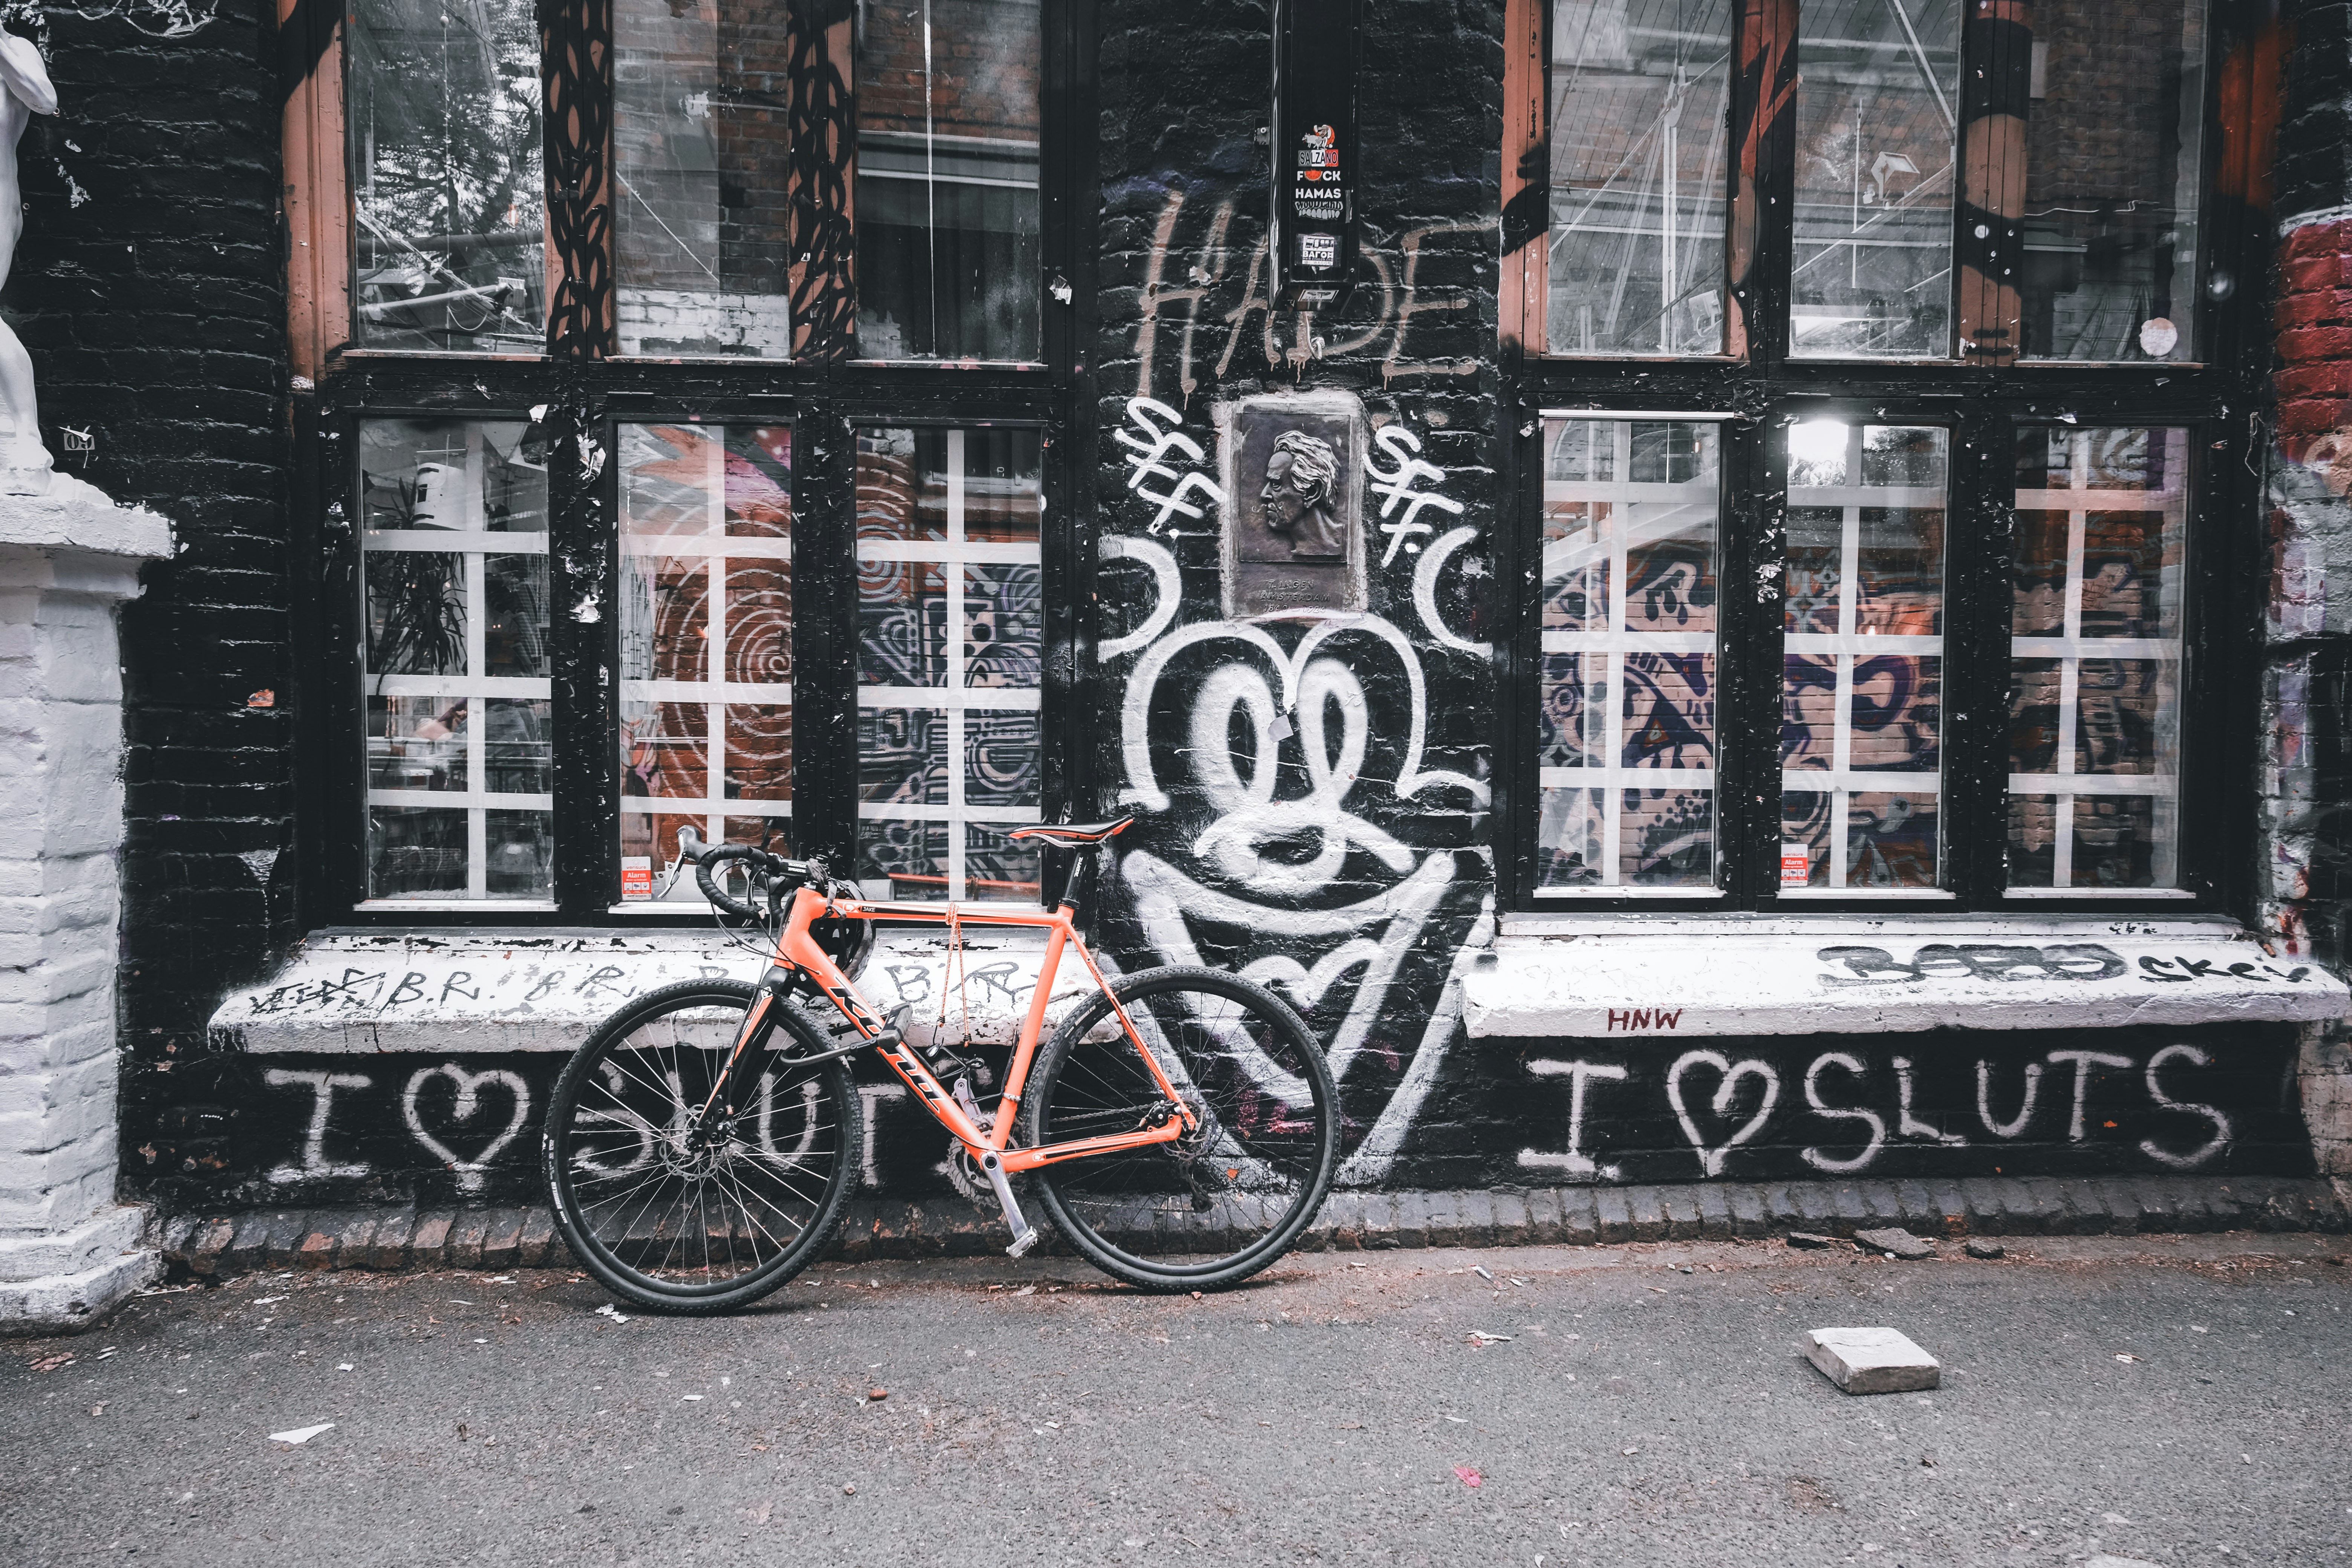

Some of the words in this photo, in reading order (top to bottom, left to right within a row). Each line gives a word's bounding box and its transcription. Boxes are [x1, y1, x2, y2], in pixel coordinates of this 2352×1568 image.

[1299, 151, 1338, 165] SALZANO
[1295, 188, 1341, 199] HAMAS
[1260, 590, 1331, 602] AMSTERDAM
[1302, 605, 1326, 613] 1924
[1608, 1008, 1682, 1032] HNW
[1802, 1044, 2232, 1172] SLUTS
[265, 1068, 373, 1184] I
[1517, 1058, 1628, 1181] I
